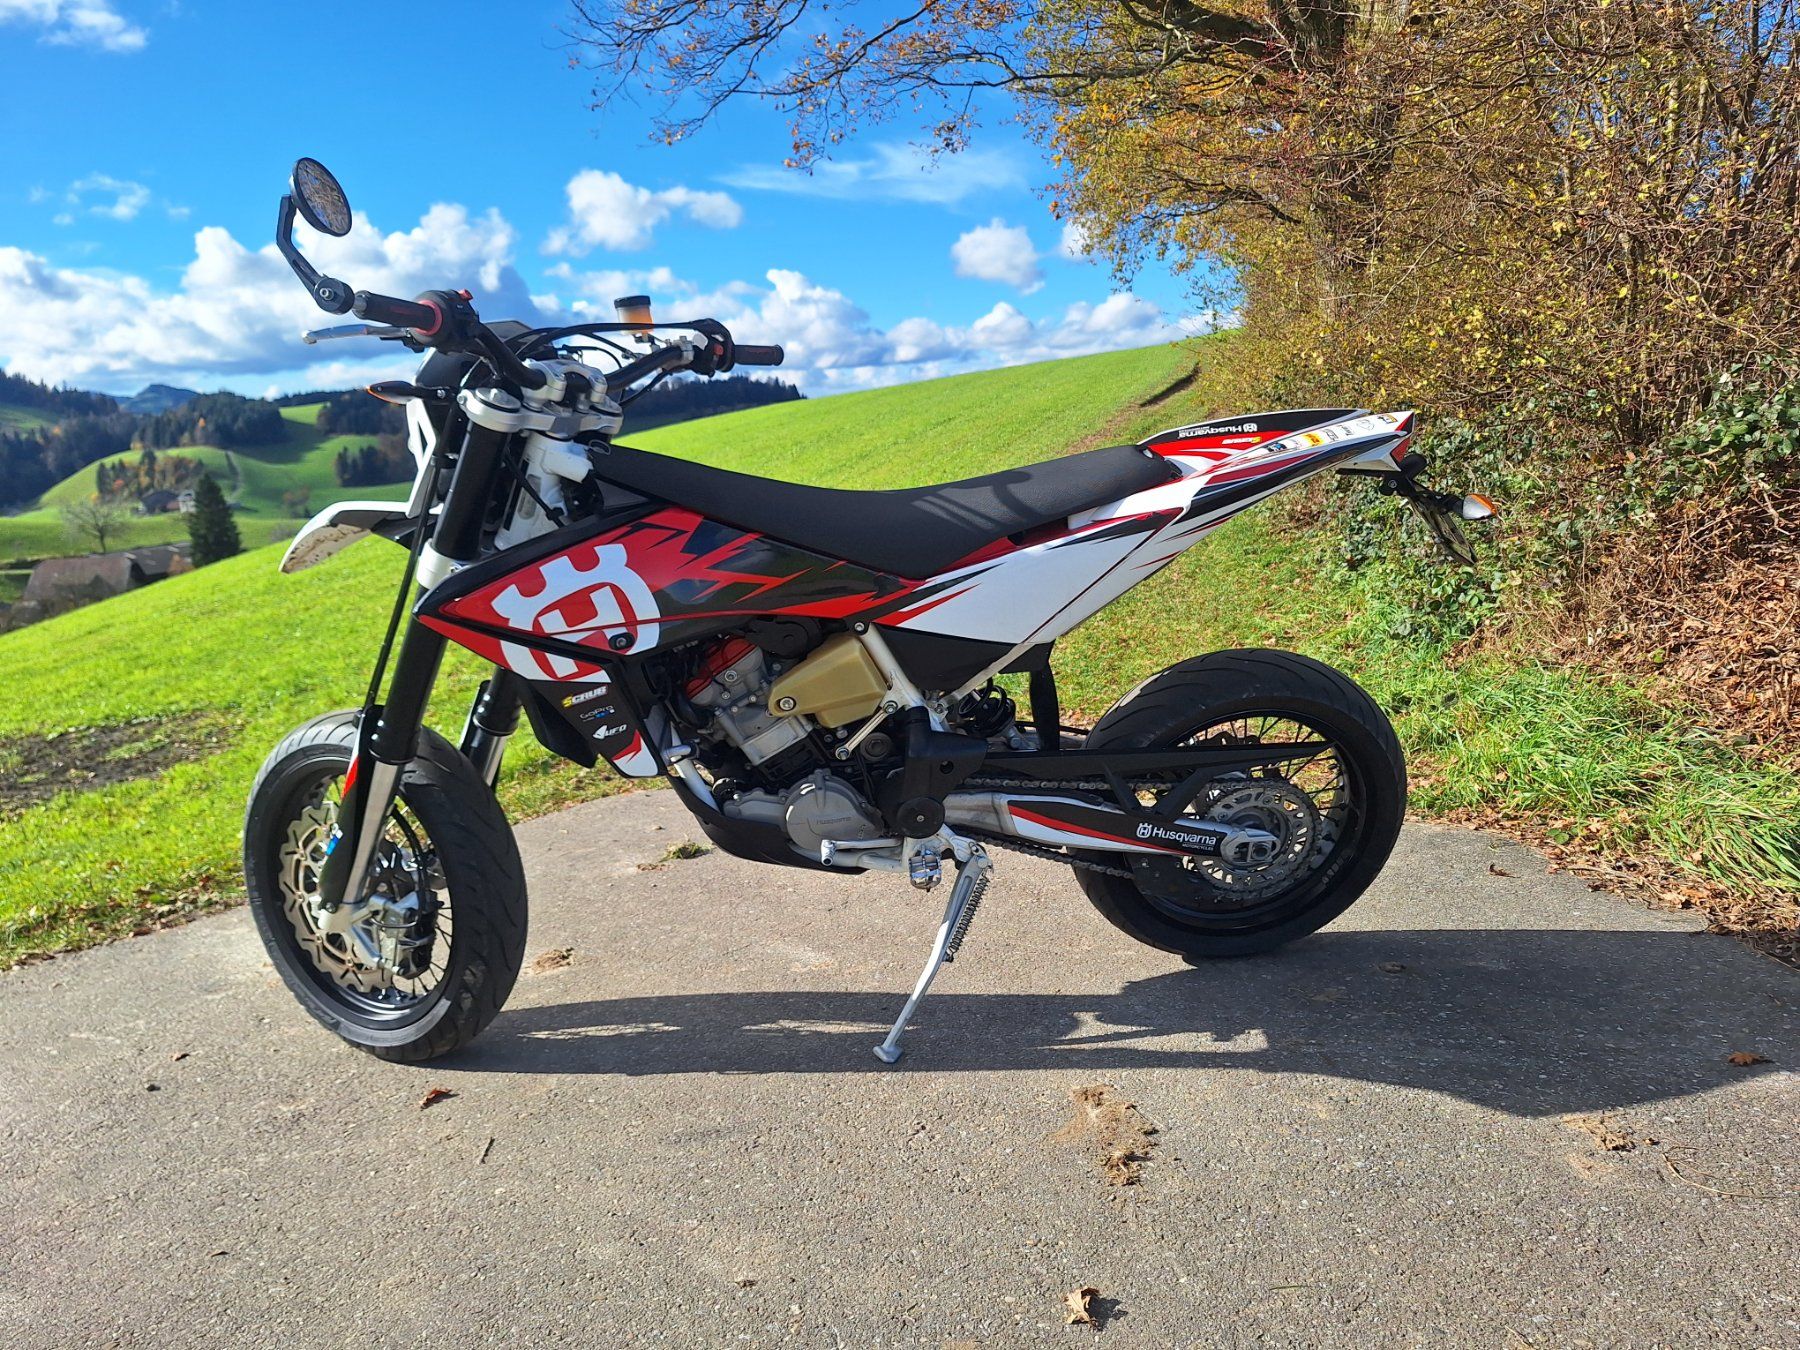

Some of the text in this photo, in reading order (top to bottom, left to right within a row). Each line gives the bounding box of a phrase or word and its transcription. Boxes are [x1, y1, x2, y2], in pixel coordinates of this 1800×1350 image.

[1178, 425, 1242, 439] Husqvarna
[580, 705, 614, 719] GoPro
[1152, 826, 1216, 845] Husqvarna
[1182, 843, 1214, 851] MOTORCYCLES
